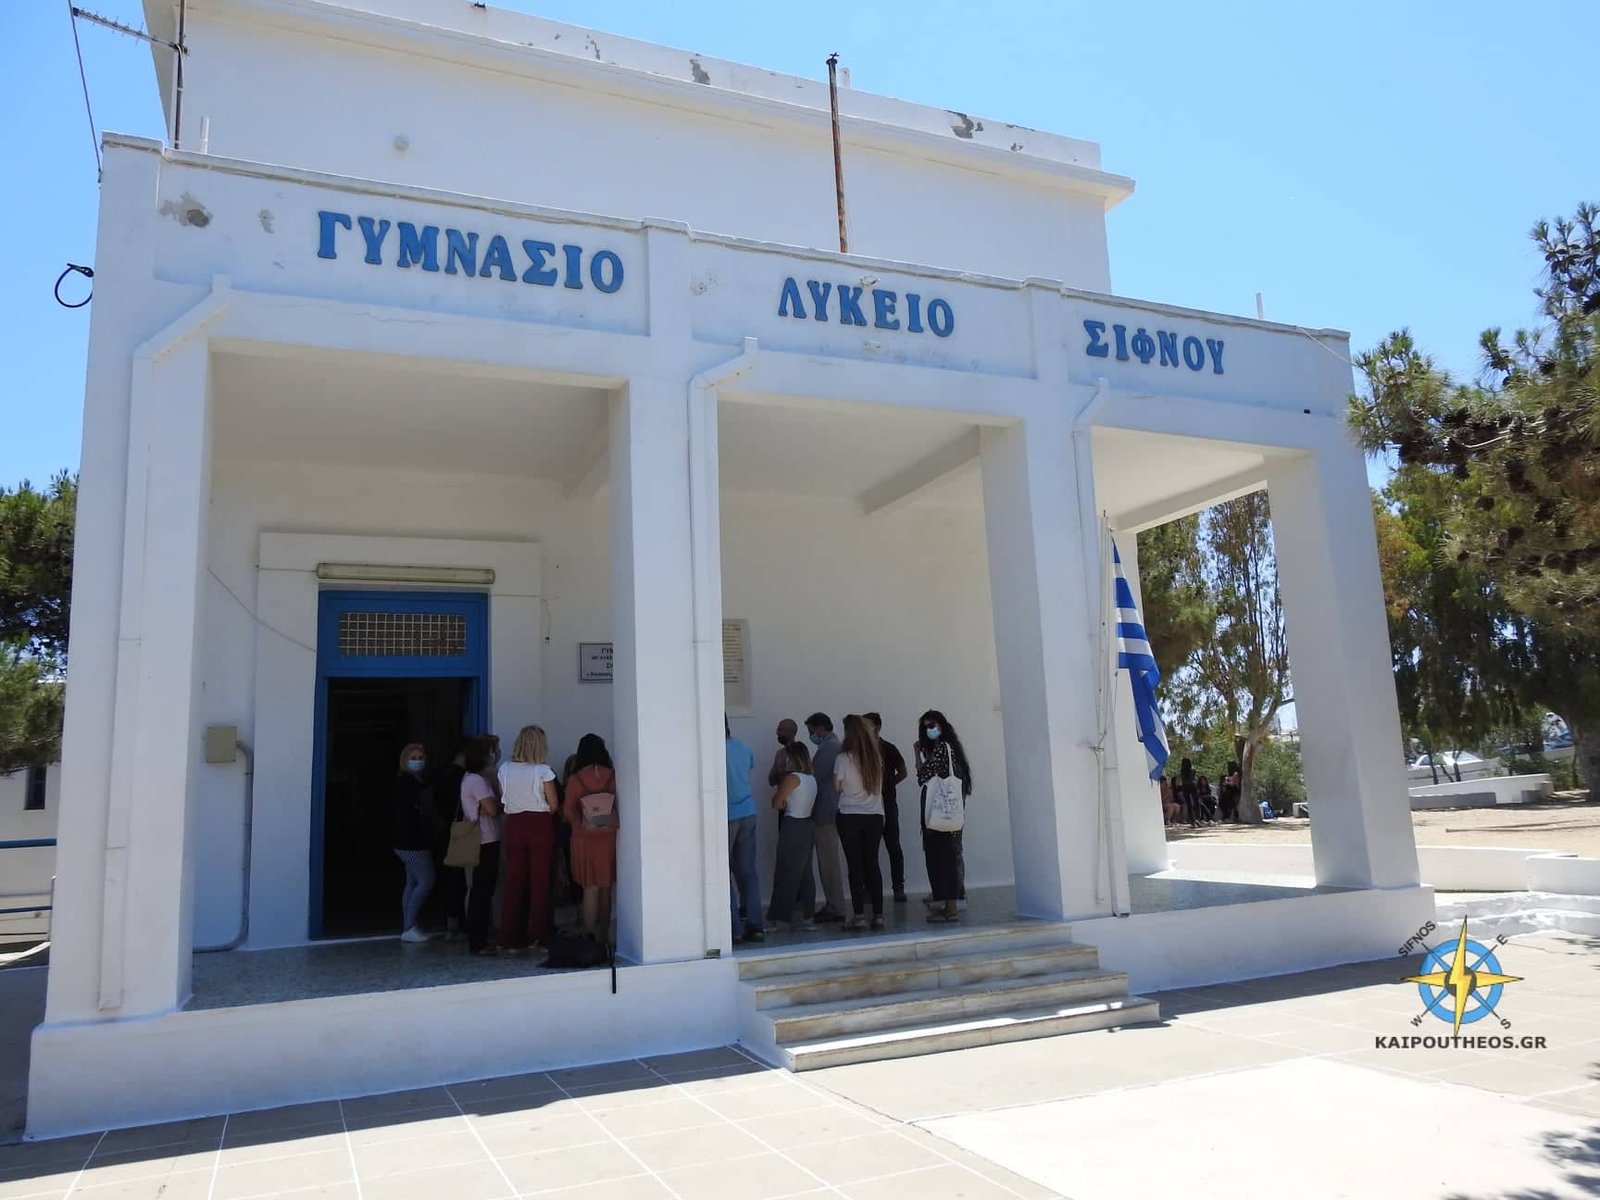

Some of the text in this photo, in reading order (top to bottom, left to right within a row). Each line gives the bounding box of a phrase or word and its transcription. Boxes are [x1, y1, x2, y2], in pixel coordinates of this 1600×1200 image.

[317, 210, 1225, 375] ΓΥΜΝΑΣΙΟ ΛΥΚΕΙΟ ΣΙΦΝΟΥ
